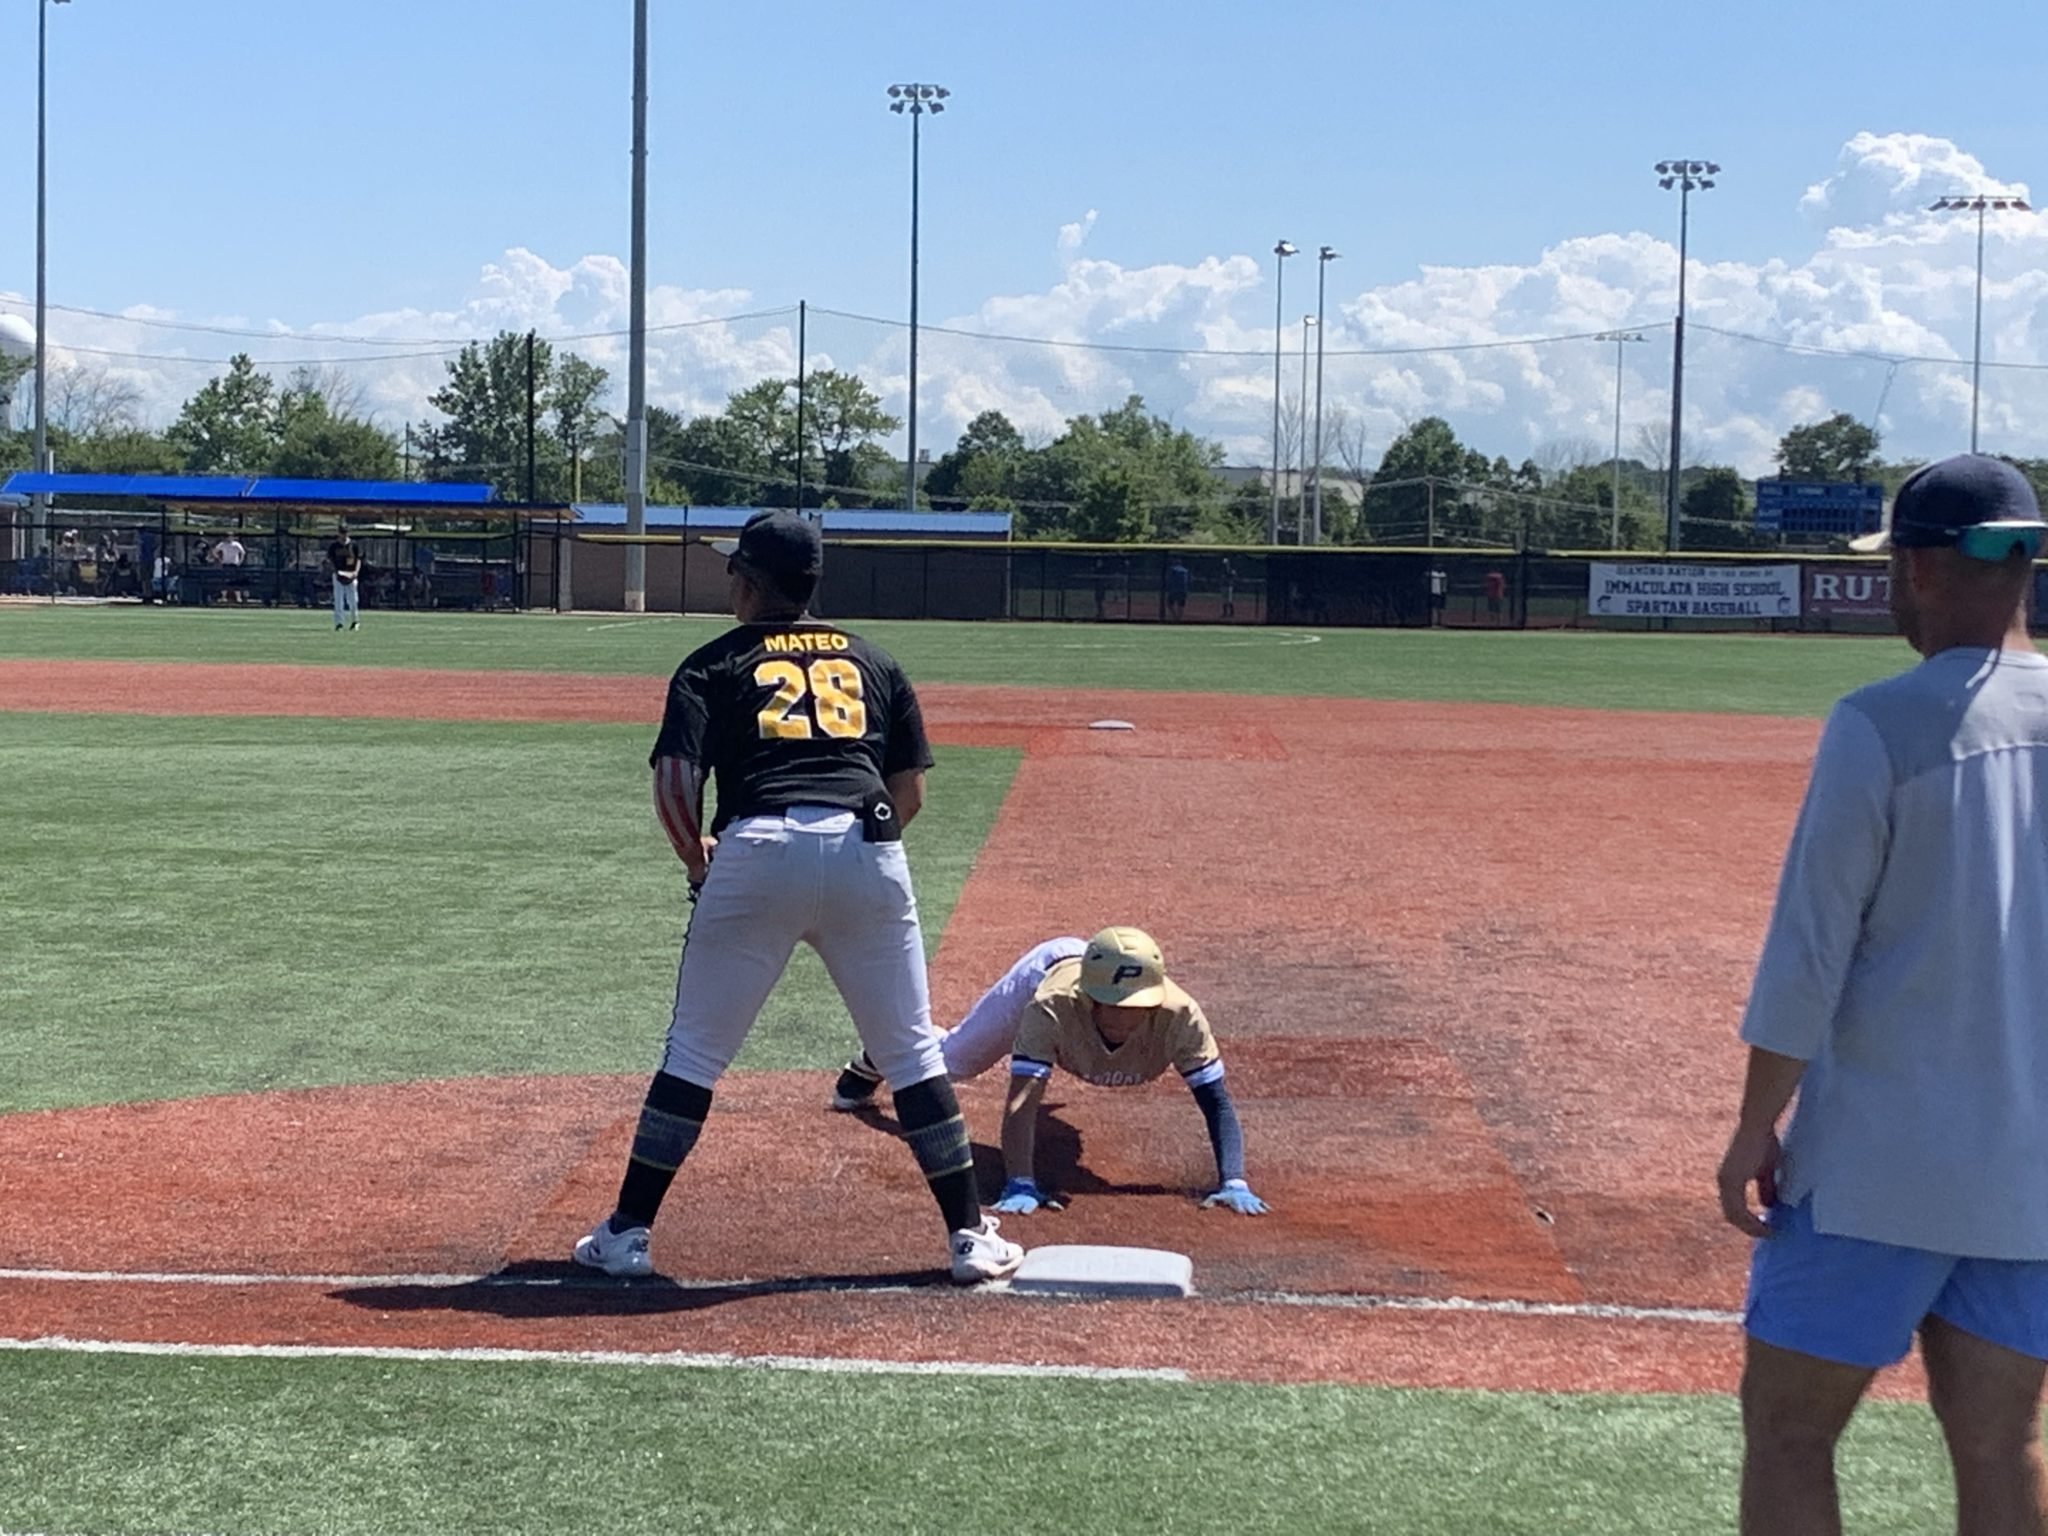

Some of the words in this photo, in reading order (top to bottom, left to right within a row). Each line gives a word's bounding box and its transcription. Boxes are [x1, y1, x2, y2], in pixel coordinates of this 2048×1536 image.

[1605, 580, 1693, 595] IMMACULATA
[1697, 582, 1730, 596] HIGH
[1733, 581, 1785, 596] SCHOOL
[1626, 600, 1689, 614] SPARTAN
[1692, 602, 1762, 616] BASEBALL
[764, 633, 849, 651] MATEO
[753, 658, 867, 740] 28
[1112, 965, 1143, 985] P
